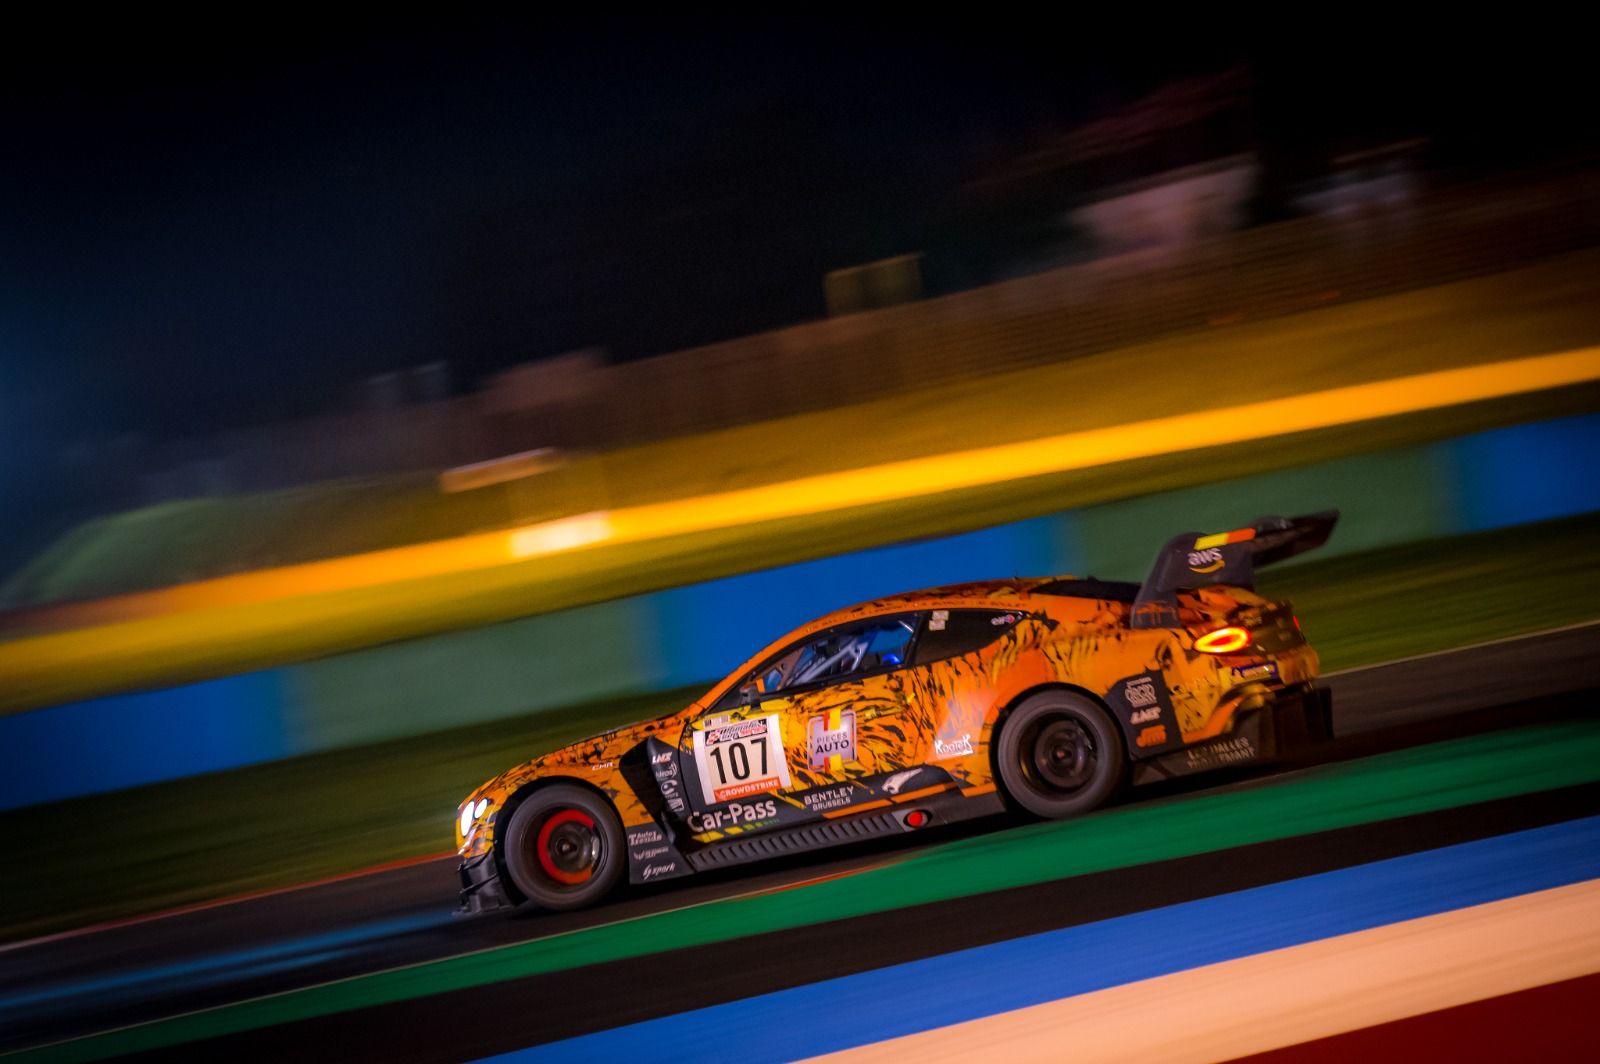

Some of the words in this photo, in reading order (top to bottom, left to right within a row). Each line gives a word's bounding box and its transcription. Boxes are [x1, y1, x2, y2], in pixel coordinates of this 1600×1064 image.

[1188, 548, 1222, 566] aws
[815, 739, 850, 755] AUTO
[710, 737, 767, 784] 107
[720, 779, 779, 799] CROWDSTRIKE
[804, 786, 854, 805] BENTLEY
[812, 796, 851, 811] BRUSSELS
[687, 799, 777, 832] Car-Pass
